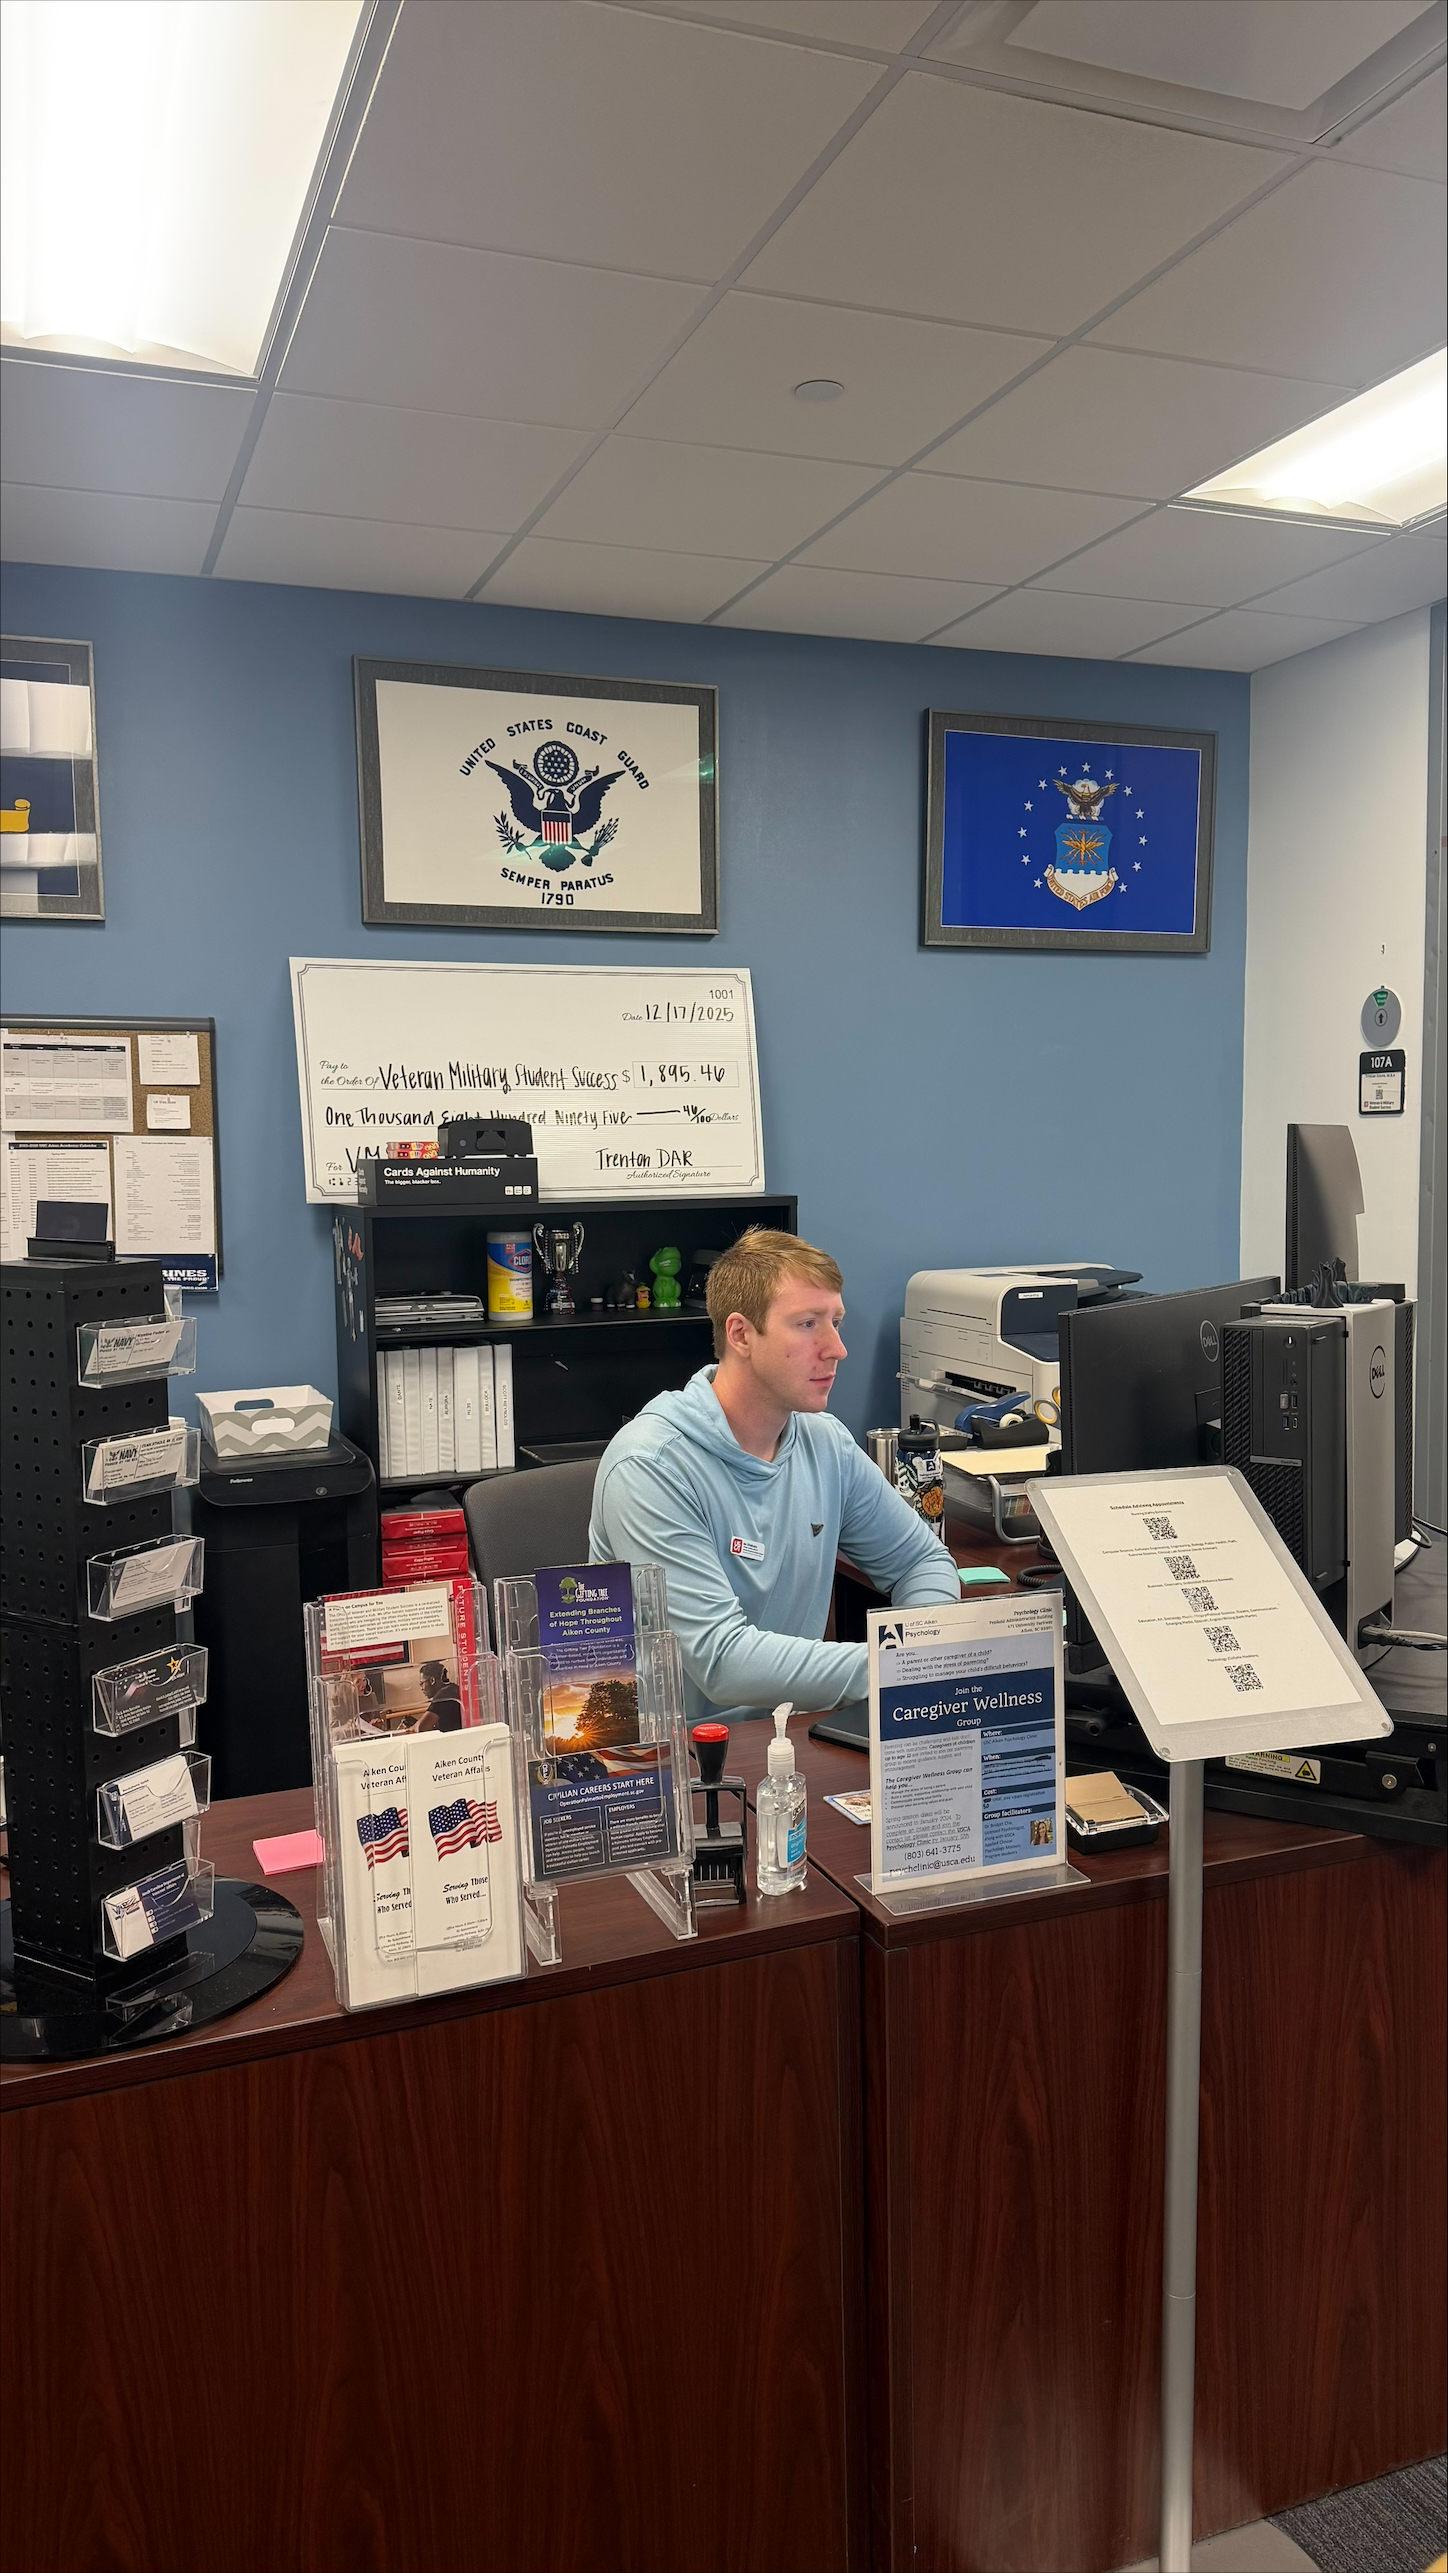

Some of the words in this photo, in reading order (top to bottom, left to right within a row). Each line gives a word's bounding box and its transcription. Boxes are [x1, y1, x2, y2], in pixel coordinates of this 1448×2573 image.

[460, 738, 496, 776] UNITED
[507, 719, 553, 738] STATES
[566, 722, 608, 745] COAST
[617, 750, 649, 790] GUARD
[500, 868, 550, 890] SEMPER
[561, 873, 614, 891] PARATUS
[541, 893, 574, 906] 1790
[709, 989, 733, 999] 1001
[622, 1013, 643, 1021] Date
[646, 1002, 734, 1022] 12/17/2025
[320, 1061, 338, 1073] Pay
[1371, 1056, 1392, 1068] 107A
[320, 1076, 335, 1086] the
[336, 1076, 362, 1086] Order
[365, 1076, 379, 1088] Of
[379, 1064, 444, 1090] Veteran
[449, 1061, 511, 1094] Military
[515, 1064, 568, 1090] Student
[572, 1066, 618, 1090] Success
[622, 1070, 630, 1083] $
[326, 1106, 354, 1126] One
[356, 1106, 434, 1126] Thousand
[556, 1110, 598, 1130] Ninety
[603, 1110, 632, 1124] Five
[326, 1162, 343, 1171] For
[596, 1148, 650, 1169] Trenton
[656, 1148, 693, 1168] DAR
[384, 1168, 414, 1177] Cards
[416, 1167, 452, 1177] Against
[455, 1167, 500, 1177] Humanity
[626, 1171, 671, 1179] Authorized
[672, 1171, 711, 1181] Signature
[1203, 1335, 1218, 1348] DELL
[1372, 1364, 1385, 1380] DELL
[550, 1609, 586, 1618] Extending
[588, 1607, 621, 1615] Branches
[580, 1616, 622, 1625] Throughout
[905, 1629, 941, 1638] Psychology
[907, 1658, 922, 1666] parent
[963, 1658, 989, 1666] parenting?
[902, 1673, 928, 1682] Struggling
[935, 1670, 955, 1678] manage
[1002, 1661, 1028, 1669] behaviors?
[955, 1687, 970, 1695] Join
[971, 1685, 983, 1693] the
[892, 1700, 969, 1722] Caregiver
[973, 1691, 1043, 1711] Wellness
[956, 1717, 982, 1728] Group
[434, 1757, 457, 1770] Aiken
[458, 1754, 484, 1768] County
[432, 1769, 463, 1783] Veteran
[548, 1789, 578, 1801] CIVILIAN
[580, 1783, 611, 1795] CAREERS
[613, 1780, 634, 1790] START
[635, 1777, 655, 1785] HERE
[609, 1804, 635, 1813] EMPLOYERS
[1002, 1808, 1032, 1816] facilitators:
[904, 1851, 924, 1861] (803)
[926, 1844, 961, 1856] 641-3775
[443, 1881, 469, 1893] Serving
[471, 1876, 489, 1886] Those
[446, 1895, 459, 1905] Who
